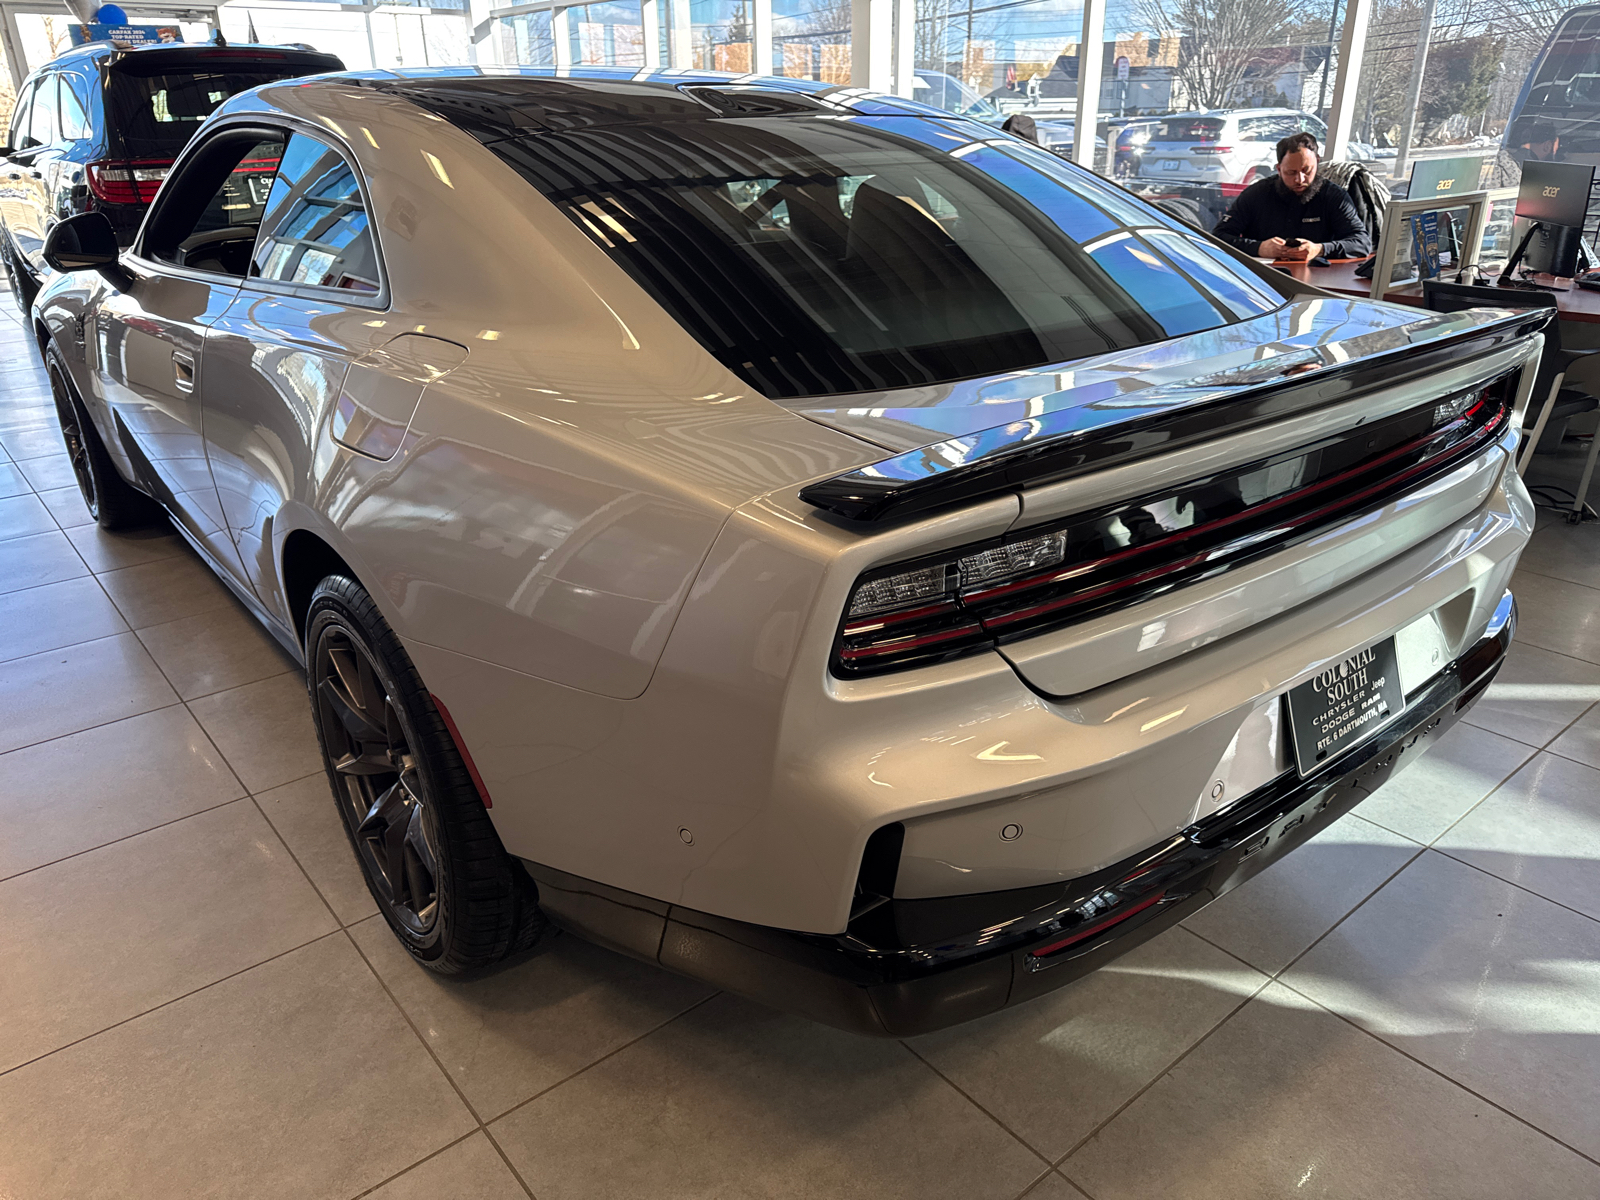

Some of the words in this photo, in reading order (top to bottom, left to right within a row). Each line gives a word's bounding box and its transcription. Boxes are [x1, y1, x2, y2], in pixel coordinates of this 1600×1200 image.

[1436, 179, 1455, 190] acer
[1542, 186, 1560, 198] acer
[1312, 647, 1376, 692] COLONIAL
[1327, 667, 1368, 706] SOUTH
[1312, 690, 1365, 726] CHRYSLER
[1371, 676, 1385, 691] Jeep
[1321, 707, 1356, 734] DODGE
[1361, 692, 1381, 710] RAM
[1316, 734, 1333, 751] RTE.
[1333, 731, 1338, 741] 6
[1339, 707, 1378, 738] DARTMOUTH,
[1378, 700, 1388, 714] MA
